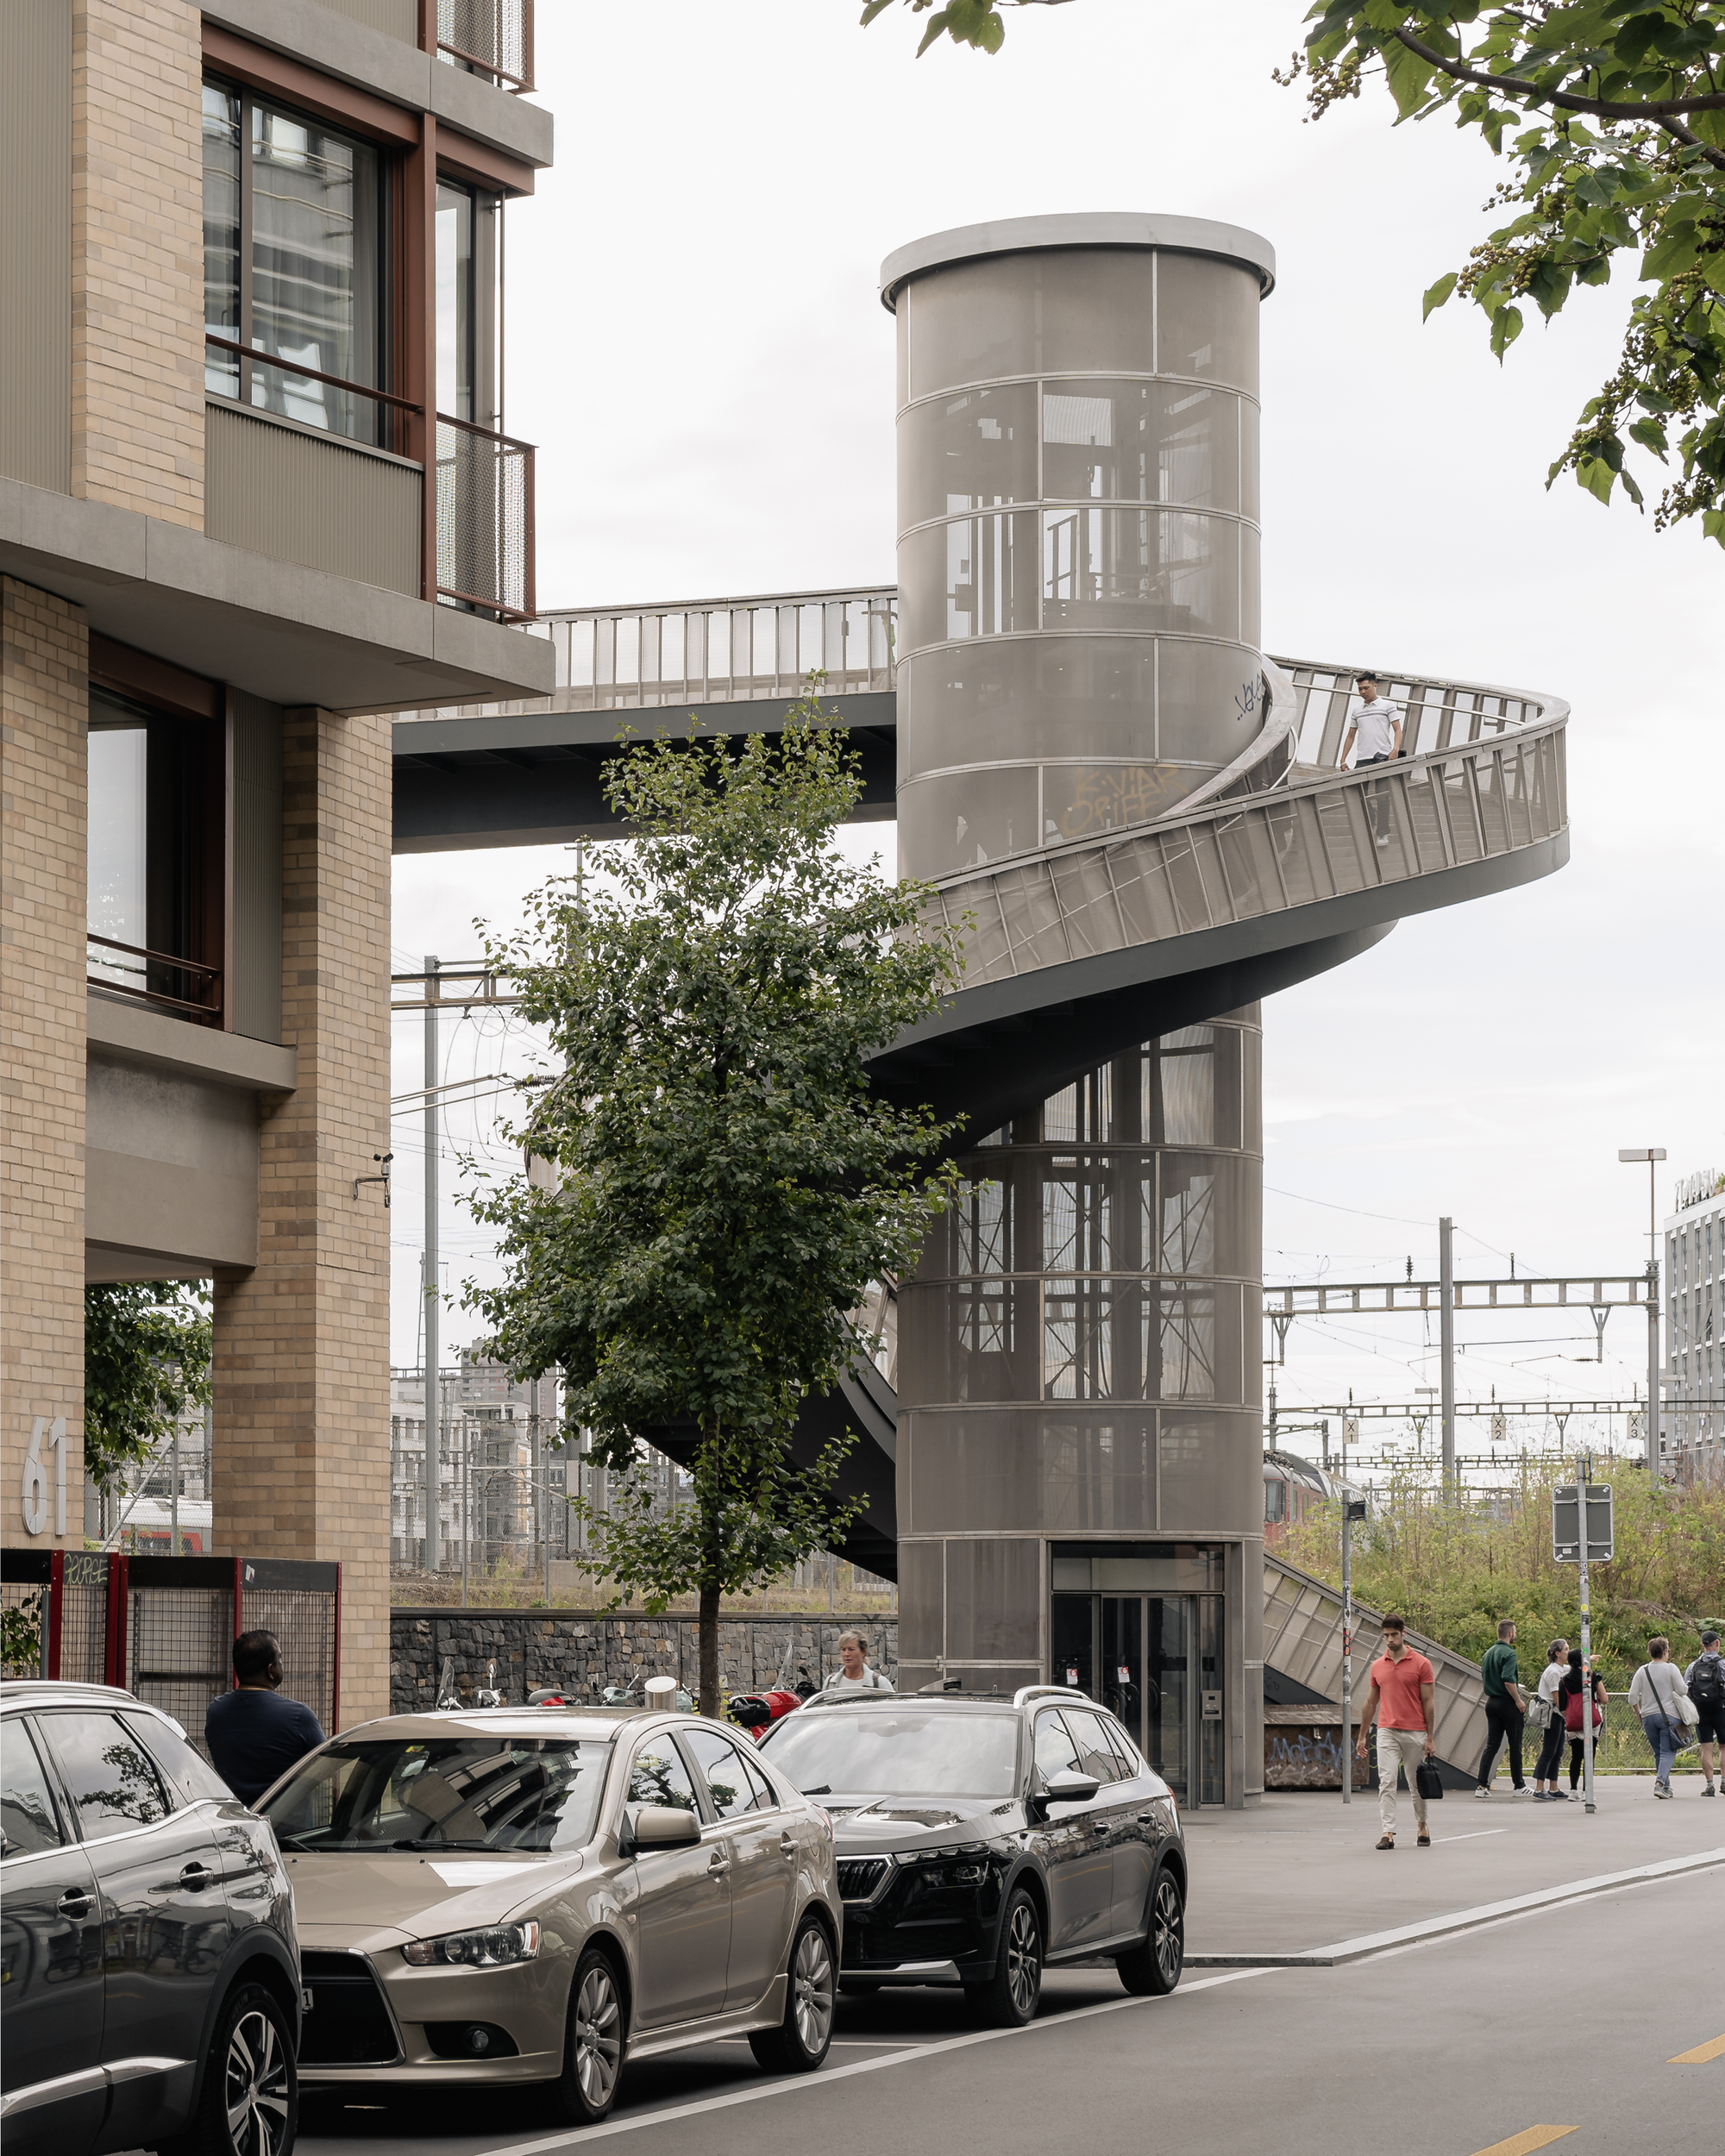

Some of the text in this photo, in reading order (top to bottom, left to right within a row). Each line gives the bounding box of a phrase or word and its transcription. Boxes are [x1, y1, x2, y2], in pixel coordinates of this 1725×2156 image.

[1495, 1420, 1502, 1428] X
[1631, 1418, 1638, 1426] X
[1348, 1423, 1354, 1432] X
[1631, 1429, 1638, 1438] 3
[22, 1416, 66, 1536] 61
[303, 1990, 310, 2006] 1
